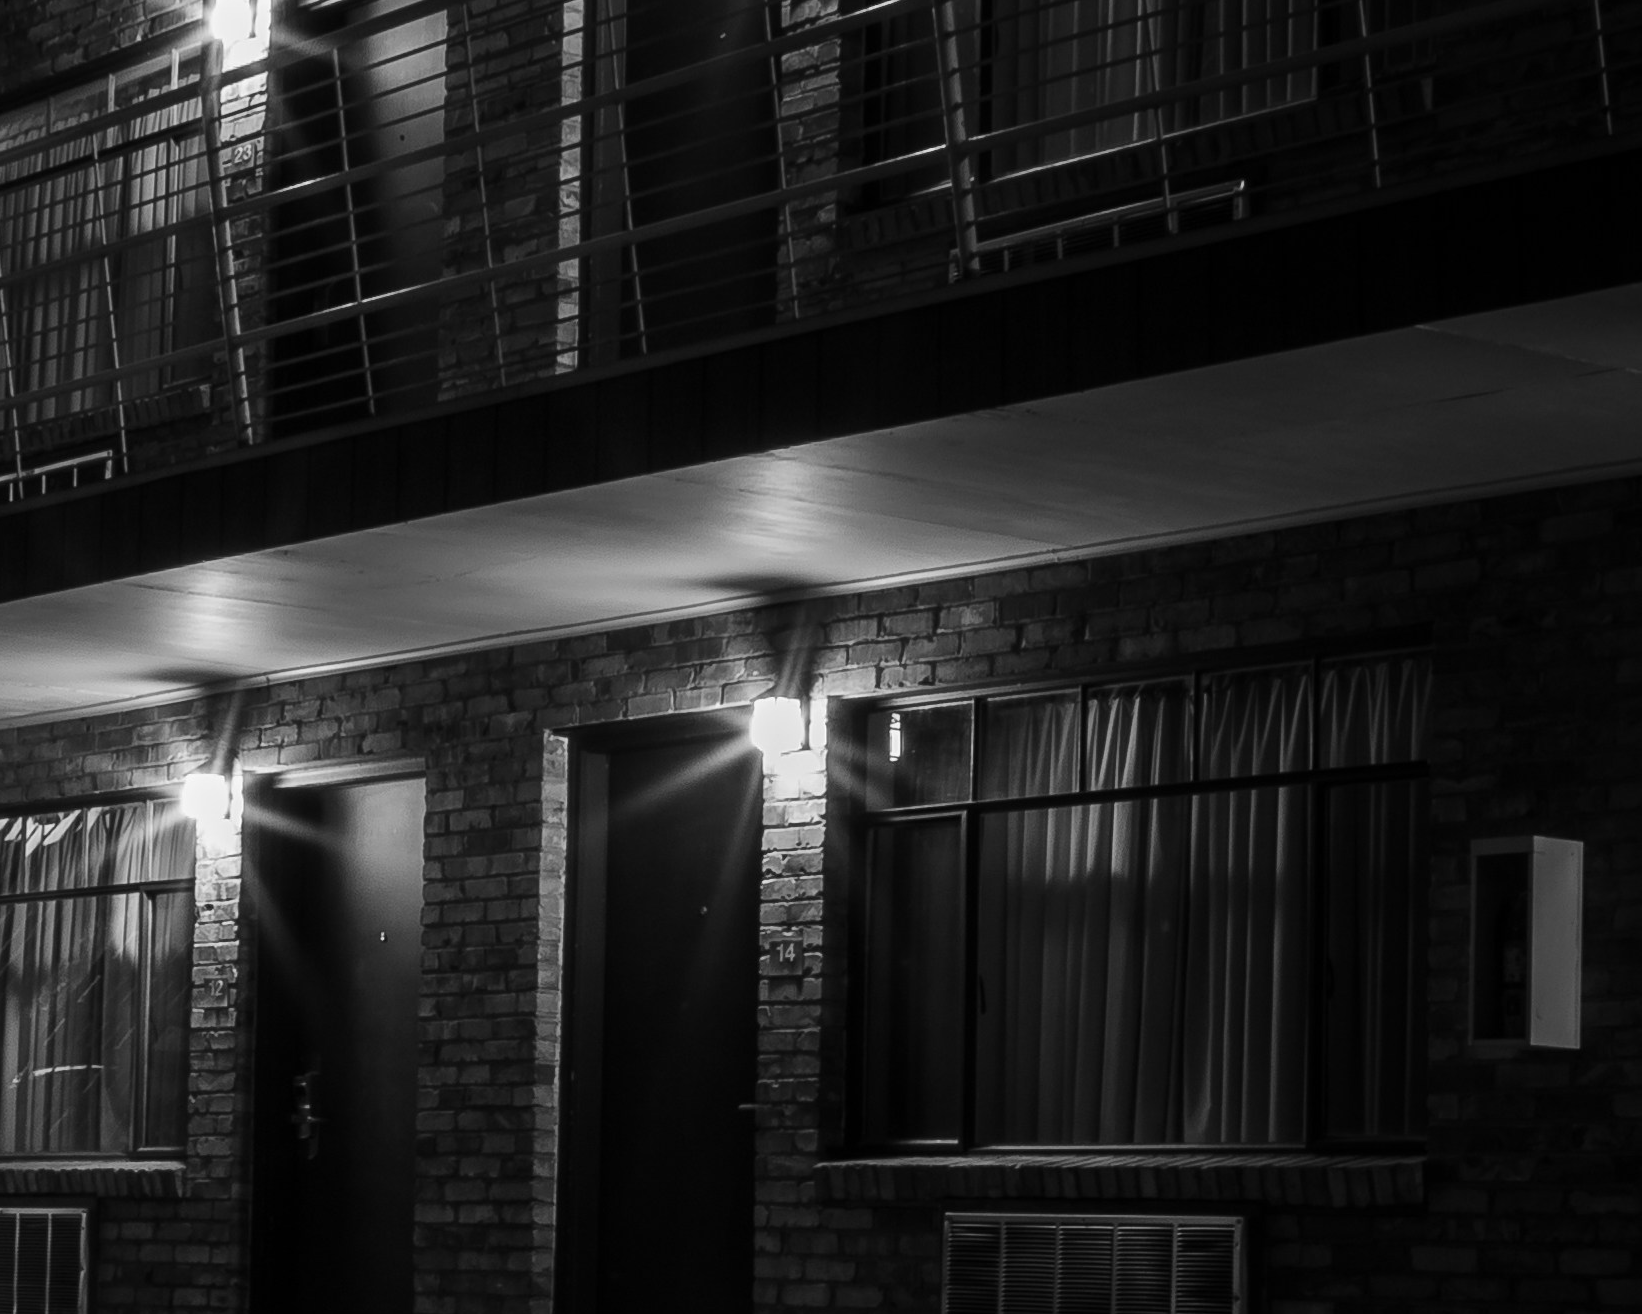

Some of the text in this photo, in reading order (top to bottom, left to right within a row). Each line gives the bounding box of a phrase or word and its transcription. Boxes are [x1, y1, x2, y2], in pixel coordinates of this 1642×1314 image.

[234, 144, 252, 163] 23
[775, 942, 796, 963] 14
[208, 979, 224, 996] 12
